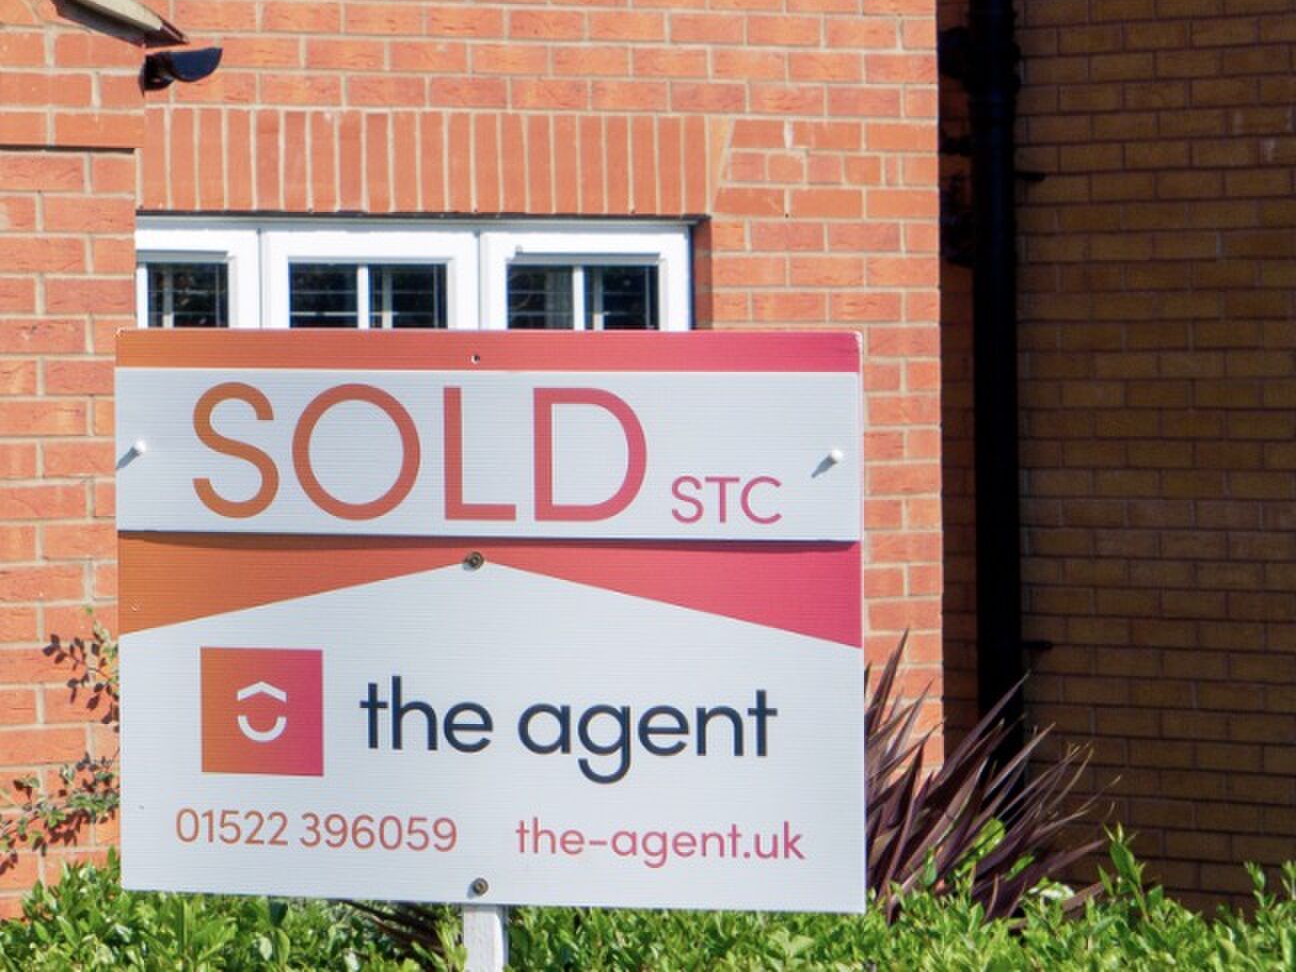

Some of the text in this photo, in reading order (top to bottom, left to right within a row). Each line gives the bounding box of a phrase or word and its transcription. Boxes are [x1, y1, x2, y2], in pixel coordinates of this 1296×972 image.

[192, 381, 782, 524] SOLD STC
[360, 675, 778, 785] the agent
[176, 808, 458, 852] 01522 396059
[516, 817, 805, 868] the-agent.uk
